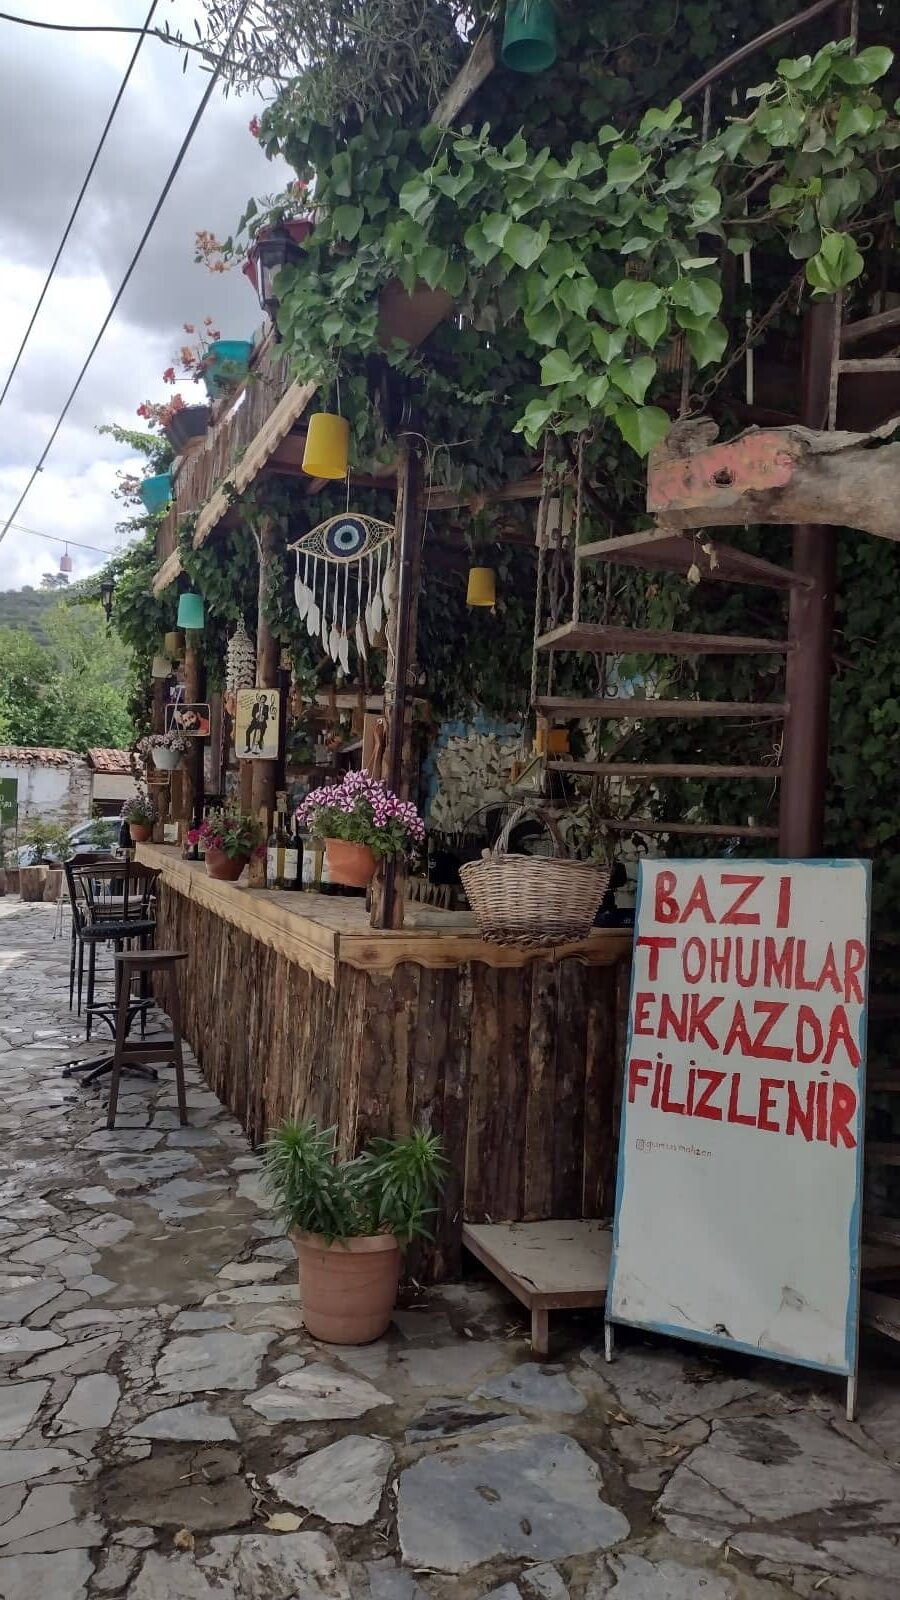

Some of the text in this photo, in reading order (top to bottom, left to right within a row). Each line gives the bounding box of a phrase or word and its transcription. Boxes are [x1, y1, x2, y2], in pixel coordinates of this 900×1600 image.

[654, 870, 791, 929] BAZI
[636, 936, 866, 1004] TOHUMLAR
[634, 992, 861, 1068] ENKAZDA
[628, 1053, 857, 1149] FİLİZLENİR
